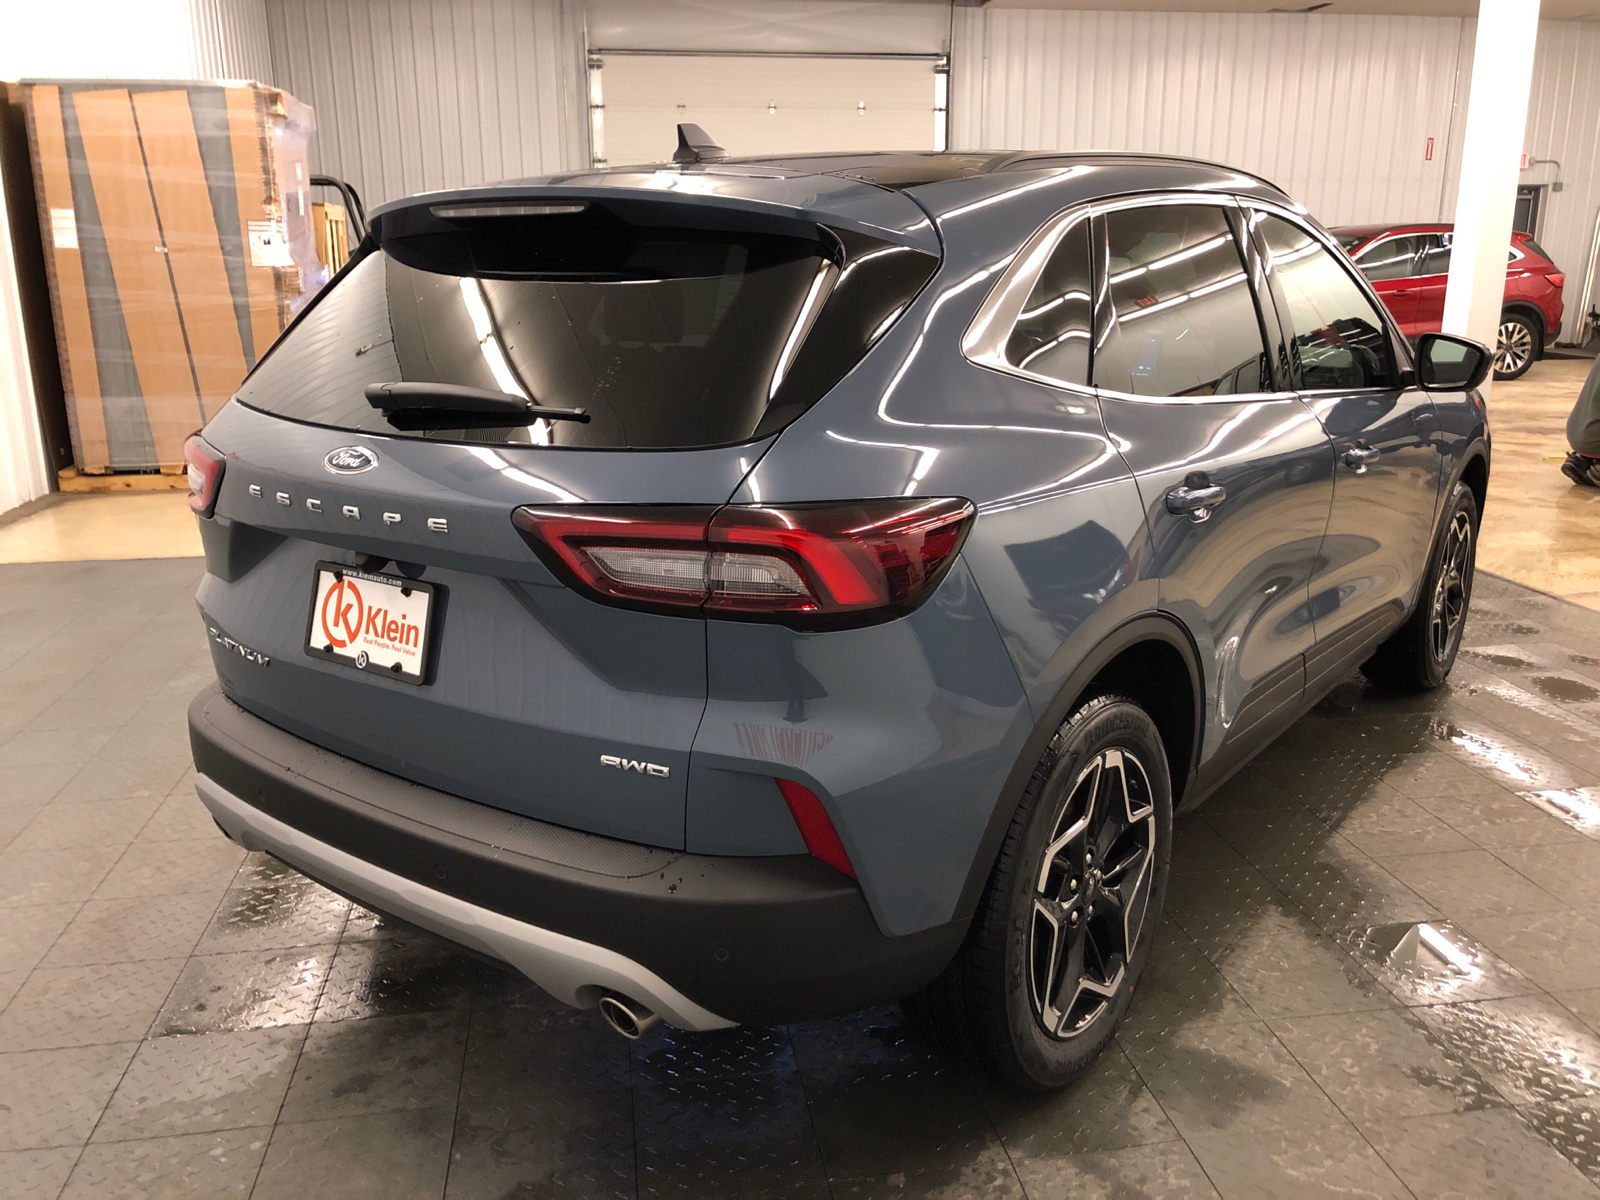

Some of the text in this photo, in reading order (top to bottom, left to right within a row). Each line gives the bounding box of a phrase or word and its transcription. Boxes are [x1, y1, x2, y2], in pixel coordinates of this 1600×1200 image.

[332, 449, 366, 467] Ford
[248, 484, 449, 534] ESCAPE
[341, 568, 403, 587] www.kleinauto.com
[365, 605, 419, 648] Klein
[209, 627, 269, 668] PLATINUM
[363, 636, 374, 645] Real
[391, 643, 402, 653] Real
[600, 754, 670, 778] AWD
